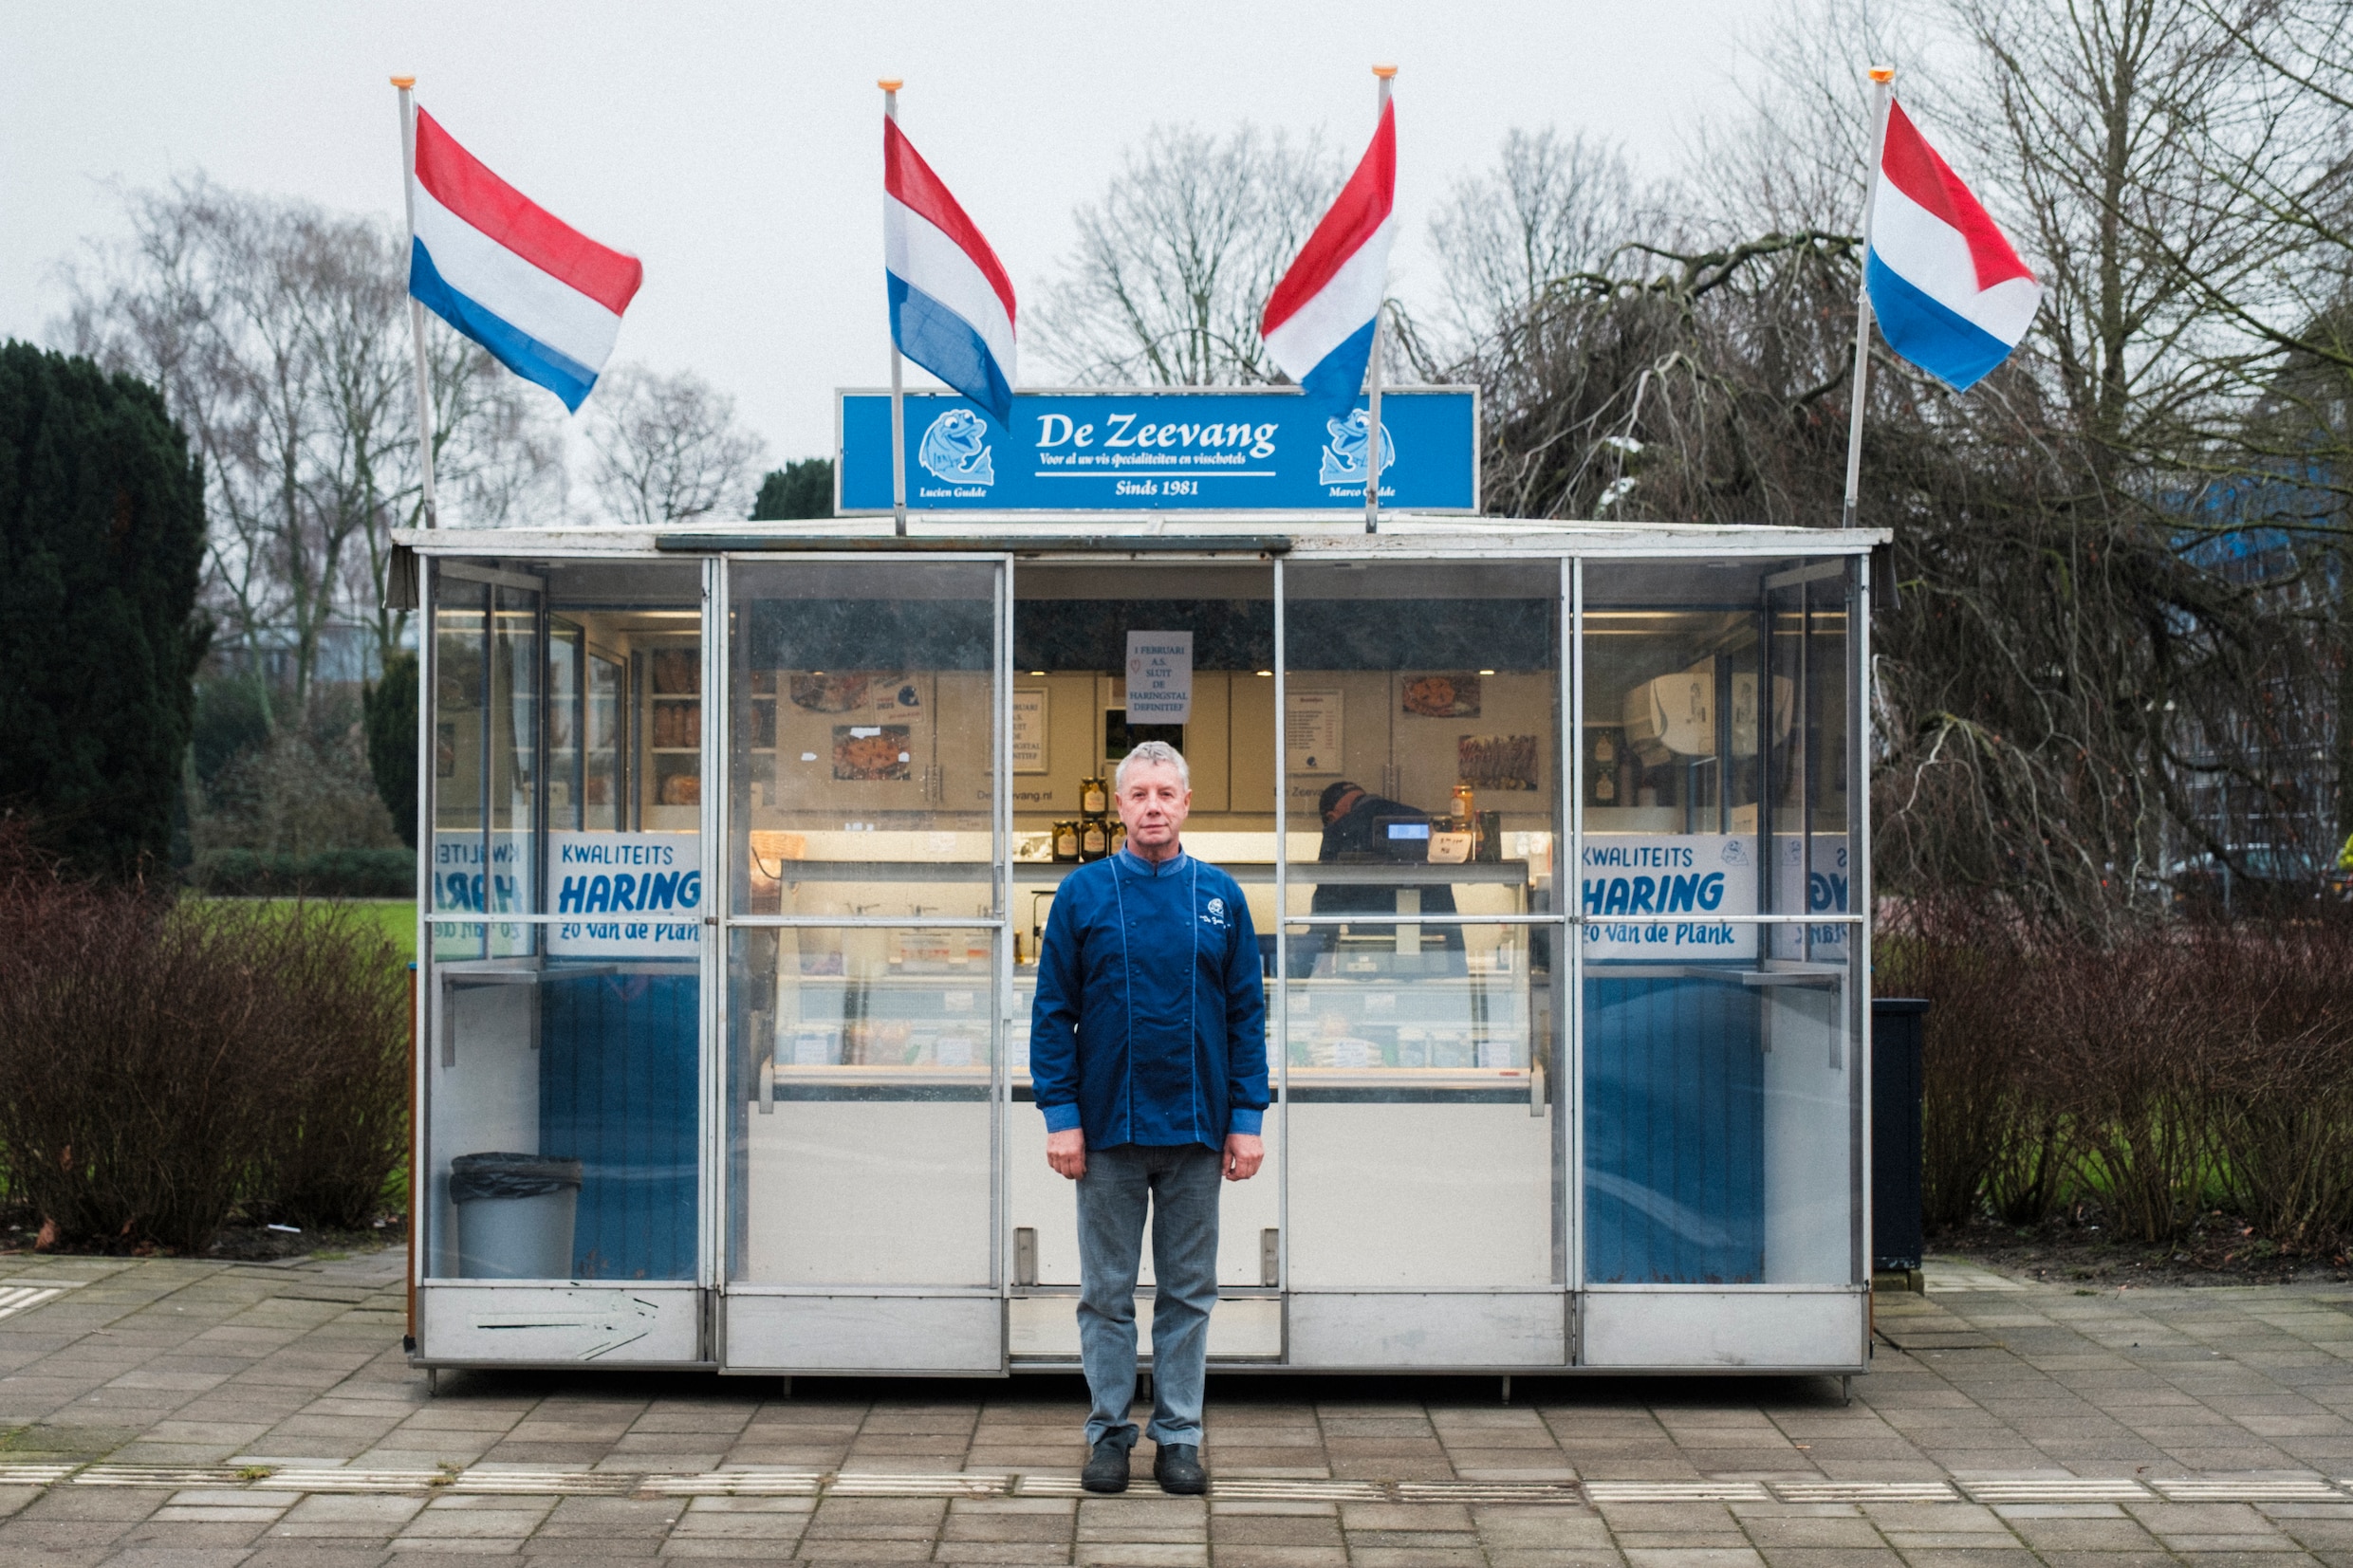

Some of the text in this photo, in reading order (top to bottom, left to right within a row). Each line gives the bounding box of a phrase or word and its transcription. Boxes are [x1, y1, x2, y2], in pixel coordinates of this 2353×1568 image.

[1035, 413, 1279, 459] De Zeevang
[1040, 452, 1246, 468] Voor al uw vis specialiteiten en visschotels
[919, 487, 987, 498] Lucien Gudde
[1115, 480, 1198, 496] Sinds 1981
[1329, 486, 1396, 497] Marco Gdde
[1140, 646, 1185, 655] FEBRUARI
[1145, 669, 1172, 677] SLUIT
[1152, 680, 1165, 689] DE
[1134, 703, 1184, 711] DEFINITIEF
[563, 844, 674, 865] KWALITEITS
[1583, 846, 1693, 867] KWALITEITS
[559, 870, 701, 913] HARING
[1582, 872, 1726, 915] HARING
[586, 923, 621, 940] van
[655, 923, 699, 942] Plan
[1604, 923, 1640, 944] van
[1644, 923, 1668, 943] de
